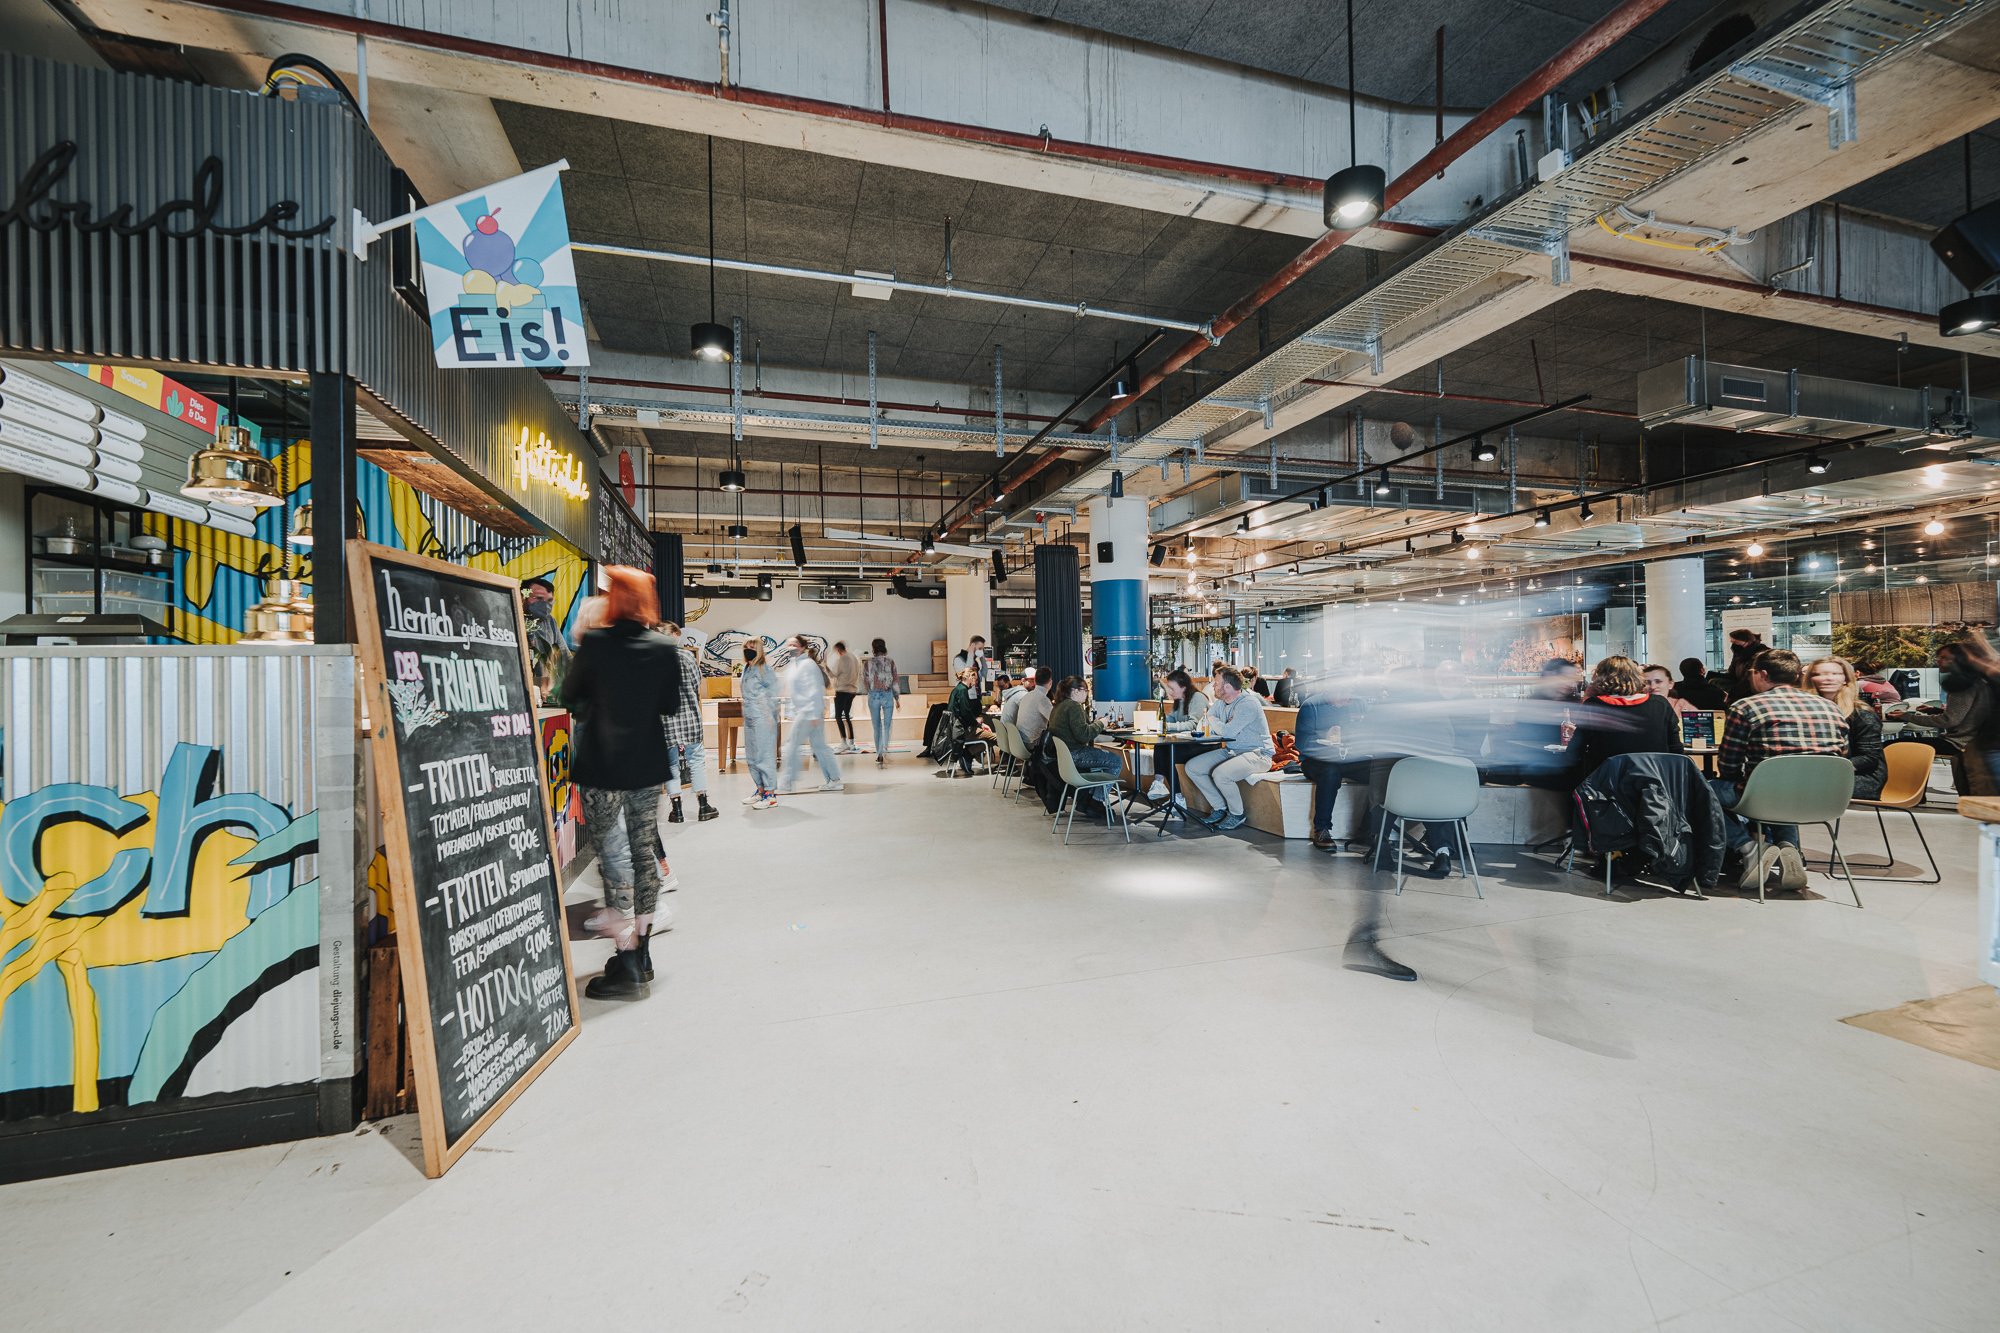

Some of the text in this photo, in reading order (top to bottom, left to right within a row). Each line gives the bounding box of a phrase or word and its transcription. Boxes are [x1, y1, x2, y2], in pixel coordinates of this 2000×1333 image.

[449, 306, 570, 361] Eis!
[120, 368, 149, 390] Sauce
[189, 397, 205, 413] Dies
[194, 413, 208, 426] Das
[461, 617, 487, 650] gutes
[488, 619, 517, 642] Essen
[393, 650, 509, 713] DER FRÜHLING
[490, 712, 532, 738] IST DA!
[525, 924, 554, 963] 9,00€
[541, 1005, 570, 1044] 7,00€
